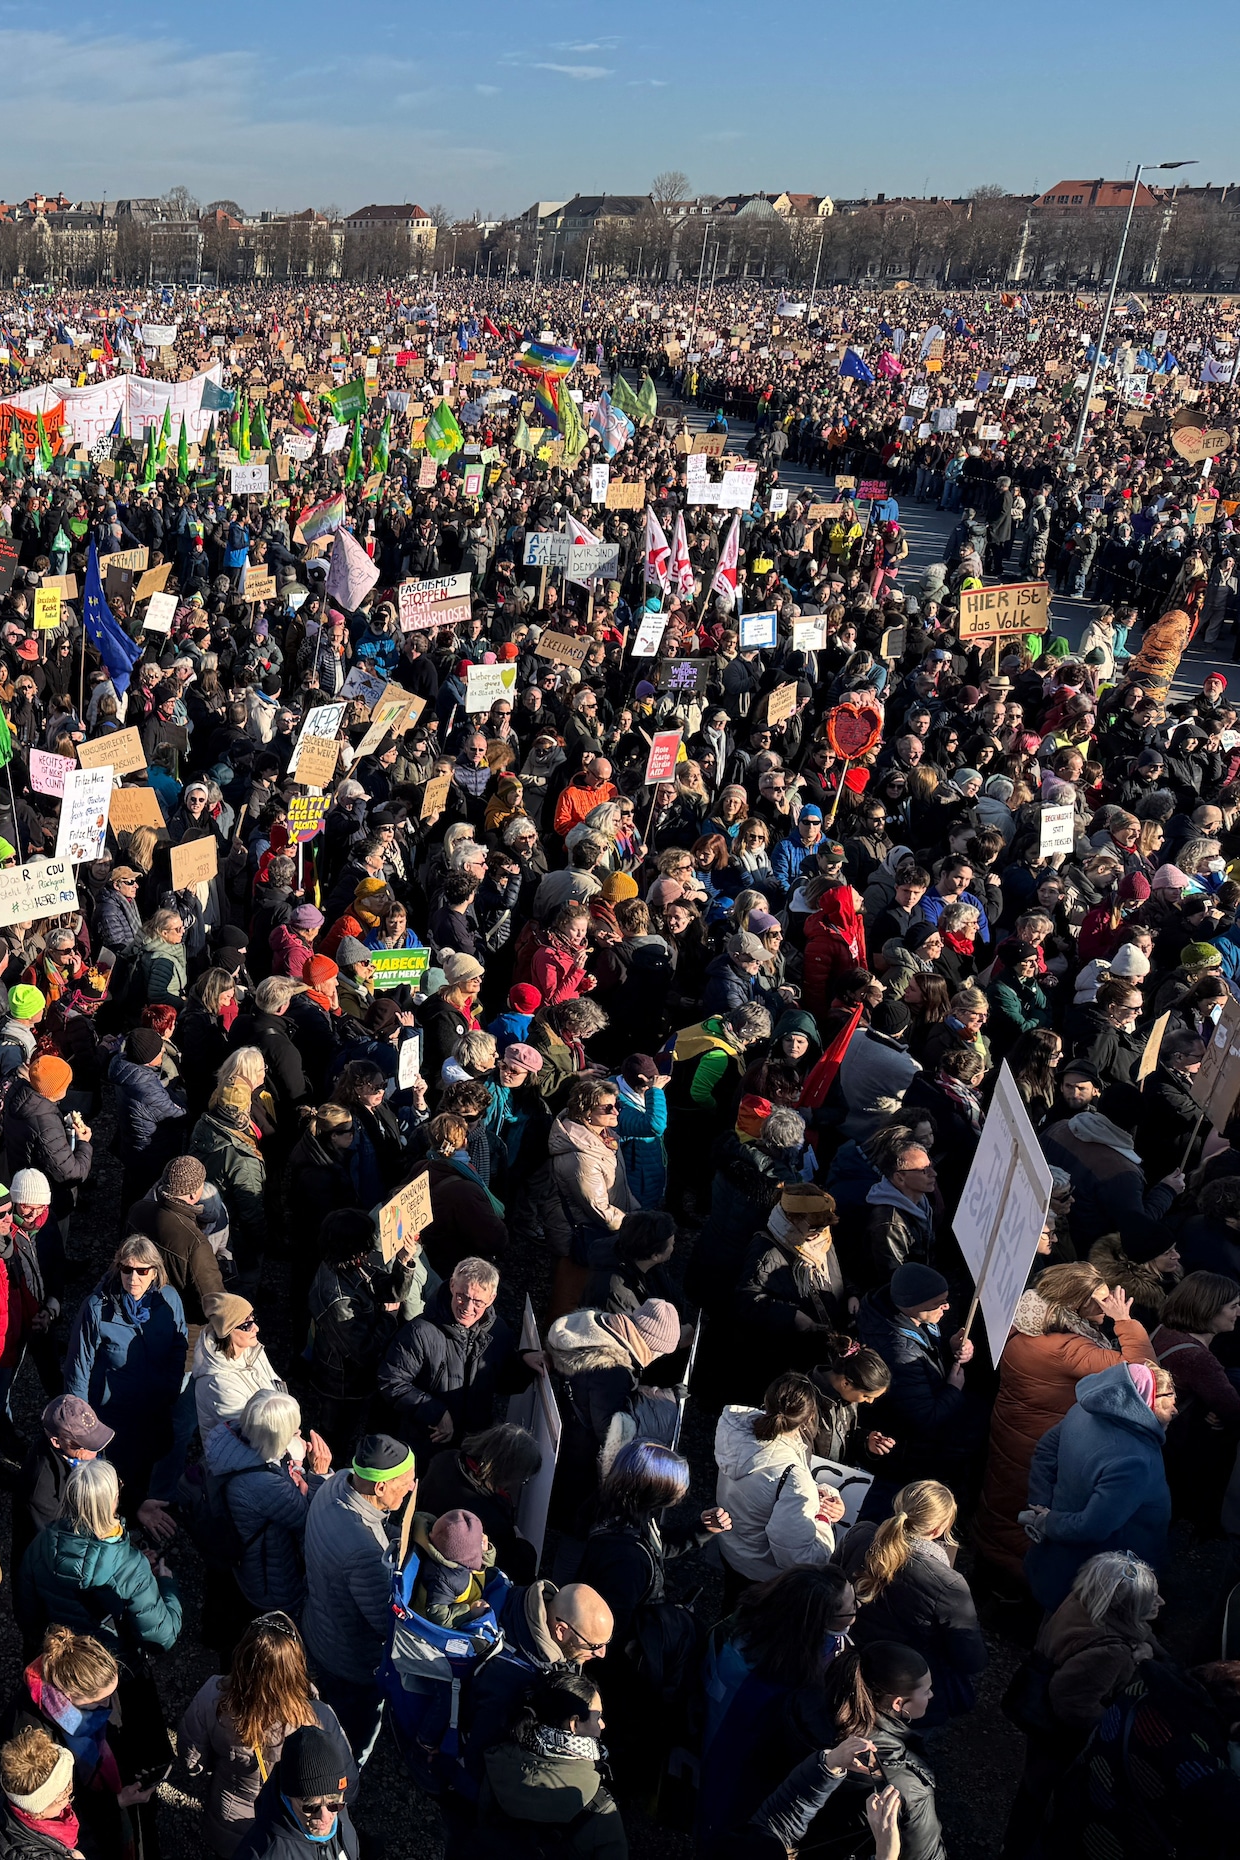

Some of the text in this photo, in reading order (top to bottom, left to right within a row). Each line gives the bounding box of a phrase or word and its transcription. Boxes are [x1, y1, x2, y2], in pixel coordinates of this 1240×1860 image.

[1202, 437, 1225, 449] HETZE
[573, 548, 614, 558] WIR SIND
[401, 576, 458, 595] FASCHISMUS
[401, 588, 448, 608] STOPPEN
[967, 591, 1009, 613] HIER
[401, 602, 431, 616] NICHT
[401, 605, 471, 631] VERHARMLOSEN
[969, 609, 1031, 632] das Volk
[671, 667, 698, 675] WIEDER
[667, 680, 697, 688] JETZT
[80, 733, 134, 758] MENSCHENRECHTE
[655, 746, 669, 754] Rote
[39, 755, 63, 769] RECHTS
[99, 748, 120, 762] STATT
[653, 753, 671, 762] Karte
[112, 756, 142, 771] ENSCHEN
[651, 761, 671, 770] für die
[288, 809, 323, 821] GEGEN
[22, 868, 31, 881] R
[36, 870, 44, 880] in
[46, 862, 65, 876] CDU
[197, 862, 210, 878] 1933
[0, 888, 23, 901] steht
[370, 956, 426, 971] HABECK
[374, 969, 421, 980] STATT MERZ
[410, 1211, 429, 1233] AFD
